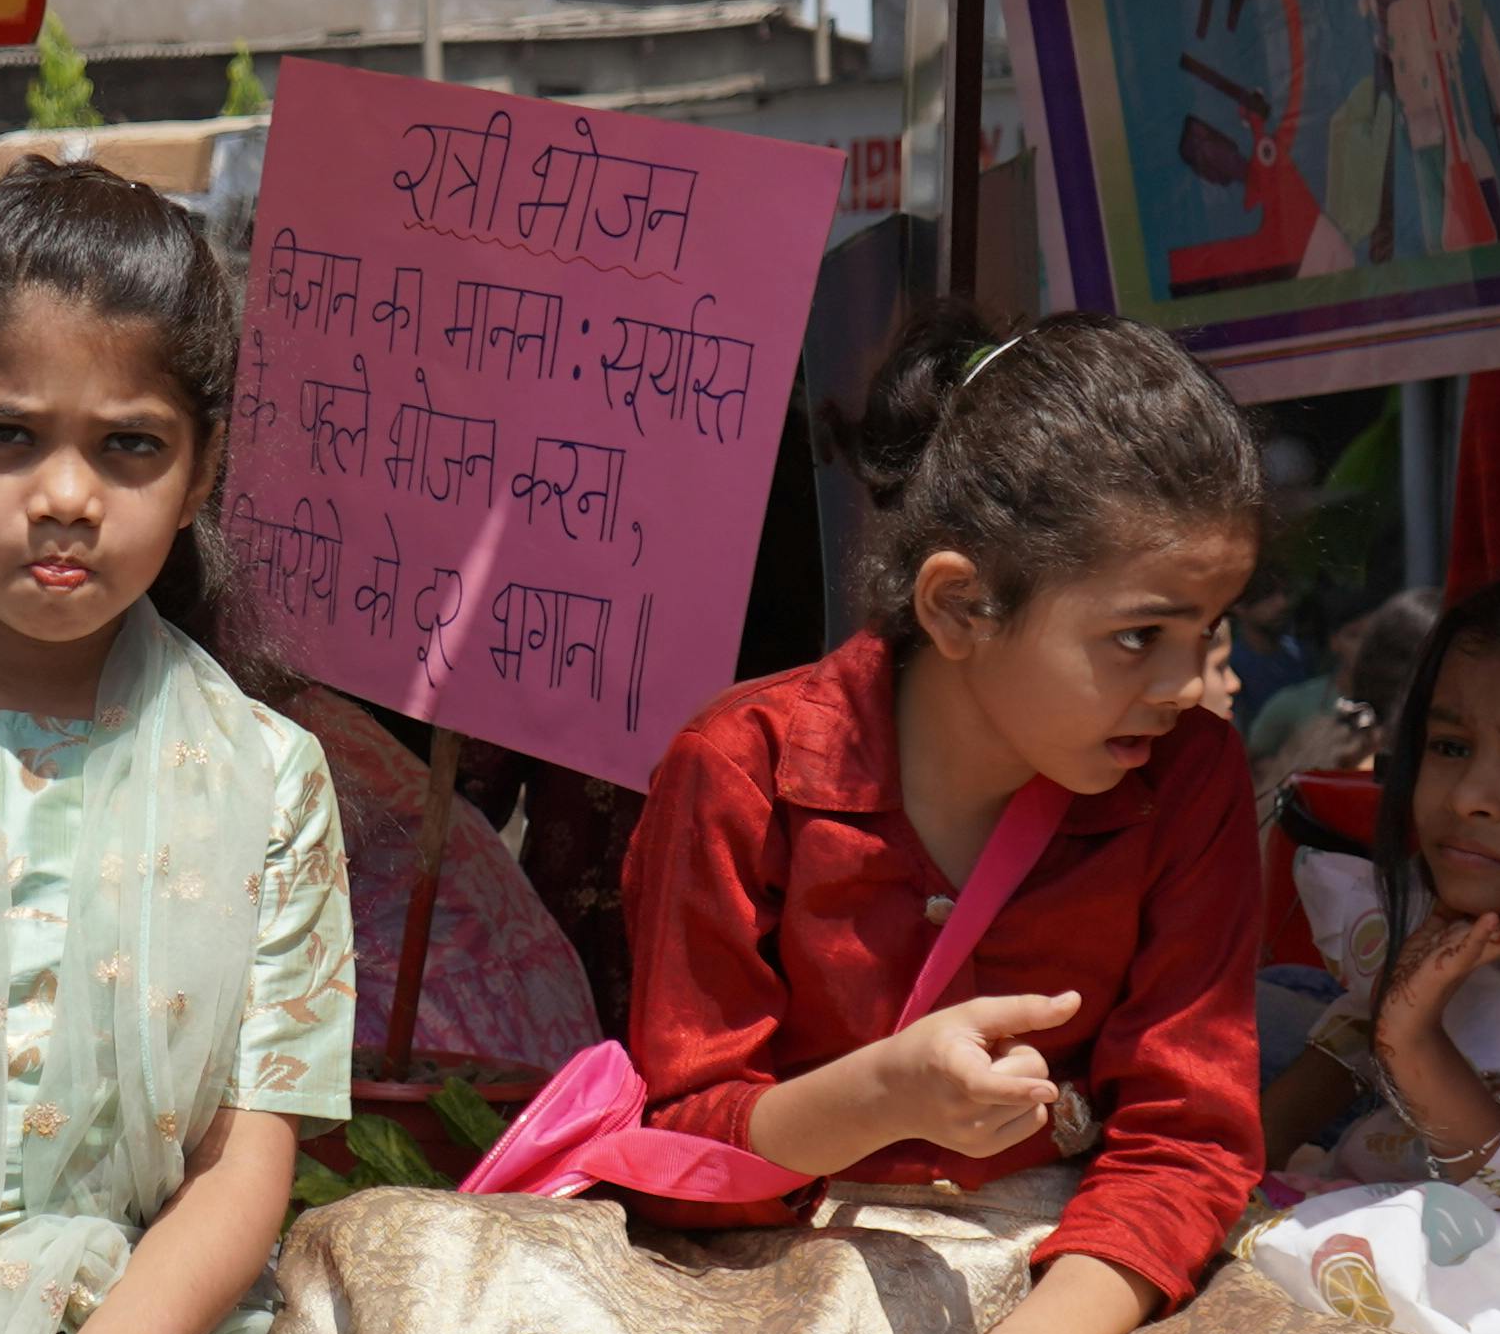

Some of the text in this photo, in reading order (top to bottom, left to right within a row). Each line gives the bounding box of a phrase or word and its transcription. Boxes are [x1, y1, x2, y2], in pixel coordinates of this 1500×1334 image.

[393, 111, 512, 232] रात्री
[518, 117, 699, 271] भोजन
[239, 329, 277, 444] के
[300, 353, 371, 477] पहले
[384, 367, 496, 509] भोजन
[372, 267, 423, 356] का
[601, 293, 754, 444] सूर्यास्त
[354, 512, 400, 639] को
[415, 567, 463, 689] दूर
